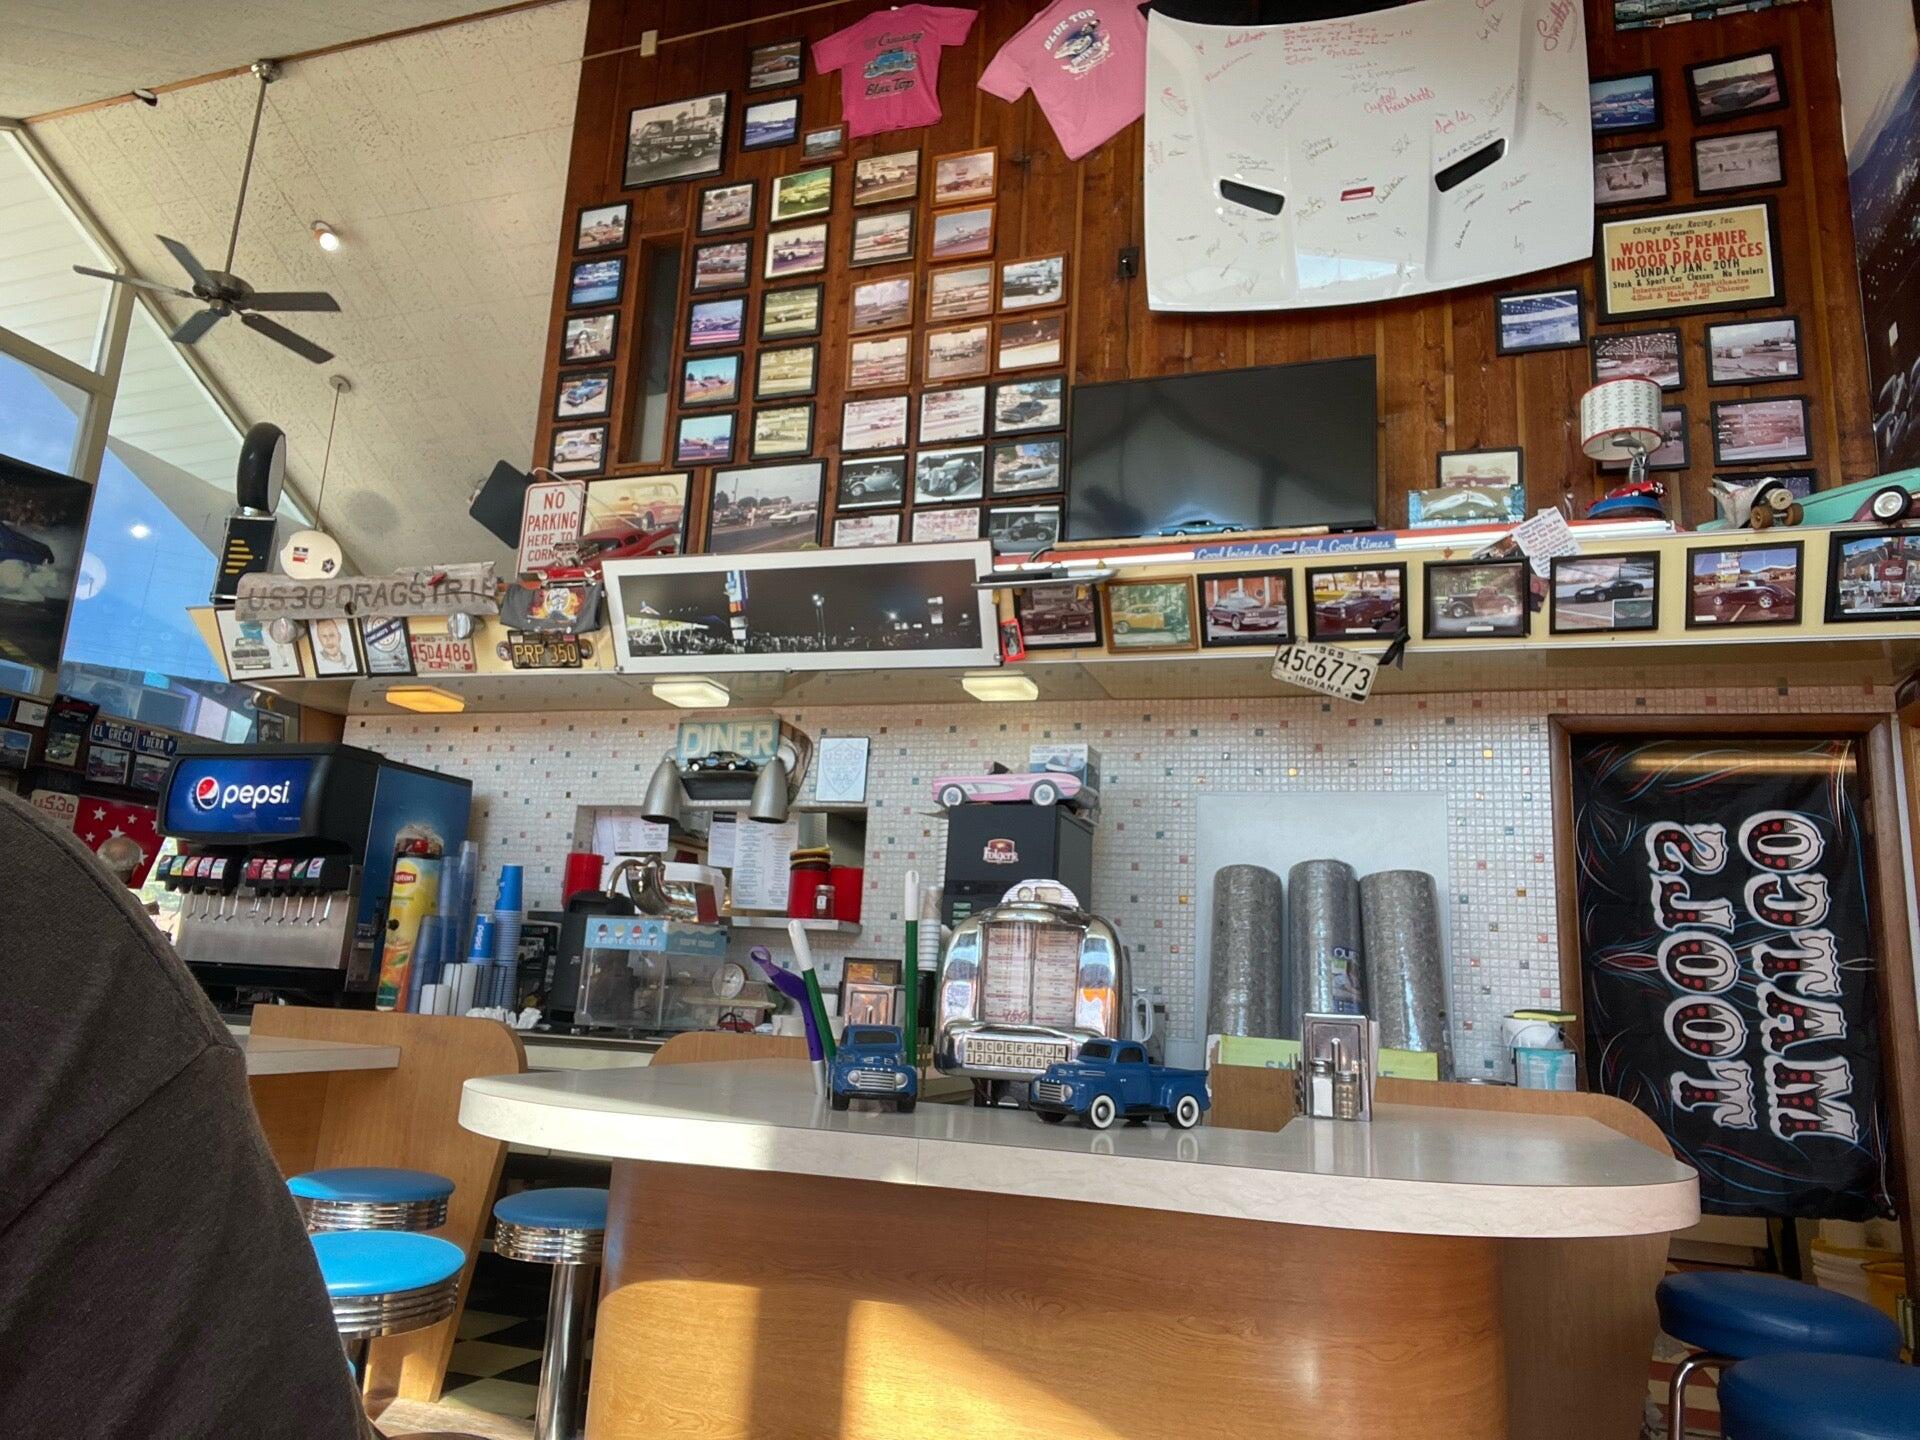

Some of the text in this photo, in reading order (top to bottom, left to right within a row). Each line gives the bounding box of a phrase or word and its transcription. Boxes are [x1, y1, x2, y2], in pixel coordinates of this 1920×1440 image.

[1044, 9, 1096, 50] BLUE TOP
[1633, 226, 1661, 235] Chicago
[1720, 217, 1735, 225] Inc.
[1670, 229, 1695, 237] Presents
[1620, 229, 1747, 256] WORLDS PREMIER
[1611, 242, 1763, 272] INDOOR DRAG RACES
[1634, 258, 1740, 279] SUNDAY JAN. 20TH
[1613, 281, 1632, 289] Stock
[1646, 278, 1666, 286] Sport
[1687, 273, 1714, 281] Classes
[1722, 270, 1732, 278] No
[543, 491, 565, 510] NO
[527, 512, 577, 532] PARKING
[527, 532, 573, 547] HERE TO
[1196, 548, 1223, 560] Good
[1268, 541, 1297, 556] Good
[1329, 537, 1358, 552] Good
[1359, 535, 1390, 549] times
[528, 548, 560, 561] CORN
[514, 645, 577, 663] PRP 350
[1278, 647, 1371, 691] 45C6773
[1295, 674, 1342, 694] INDIANA
[94, 724, 133, 744] EL GRECO
[142, 735, 174, 752] THERA P
[681, 721, 774, 757] DINER
[222, 780, 290, 810] pepsi
[983, 846, 1019, 864] Folgers
